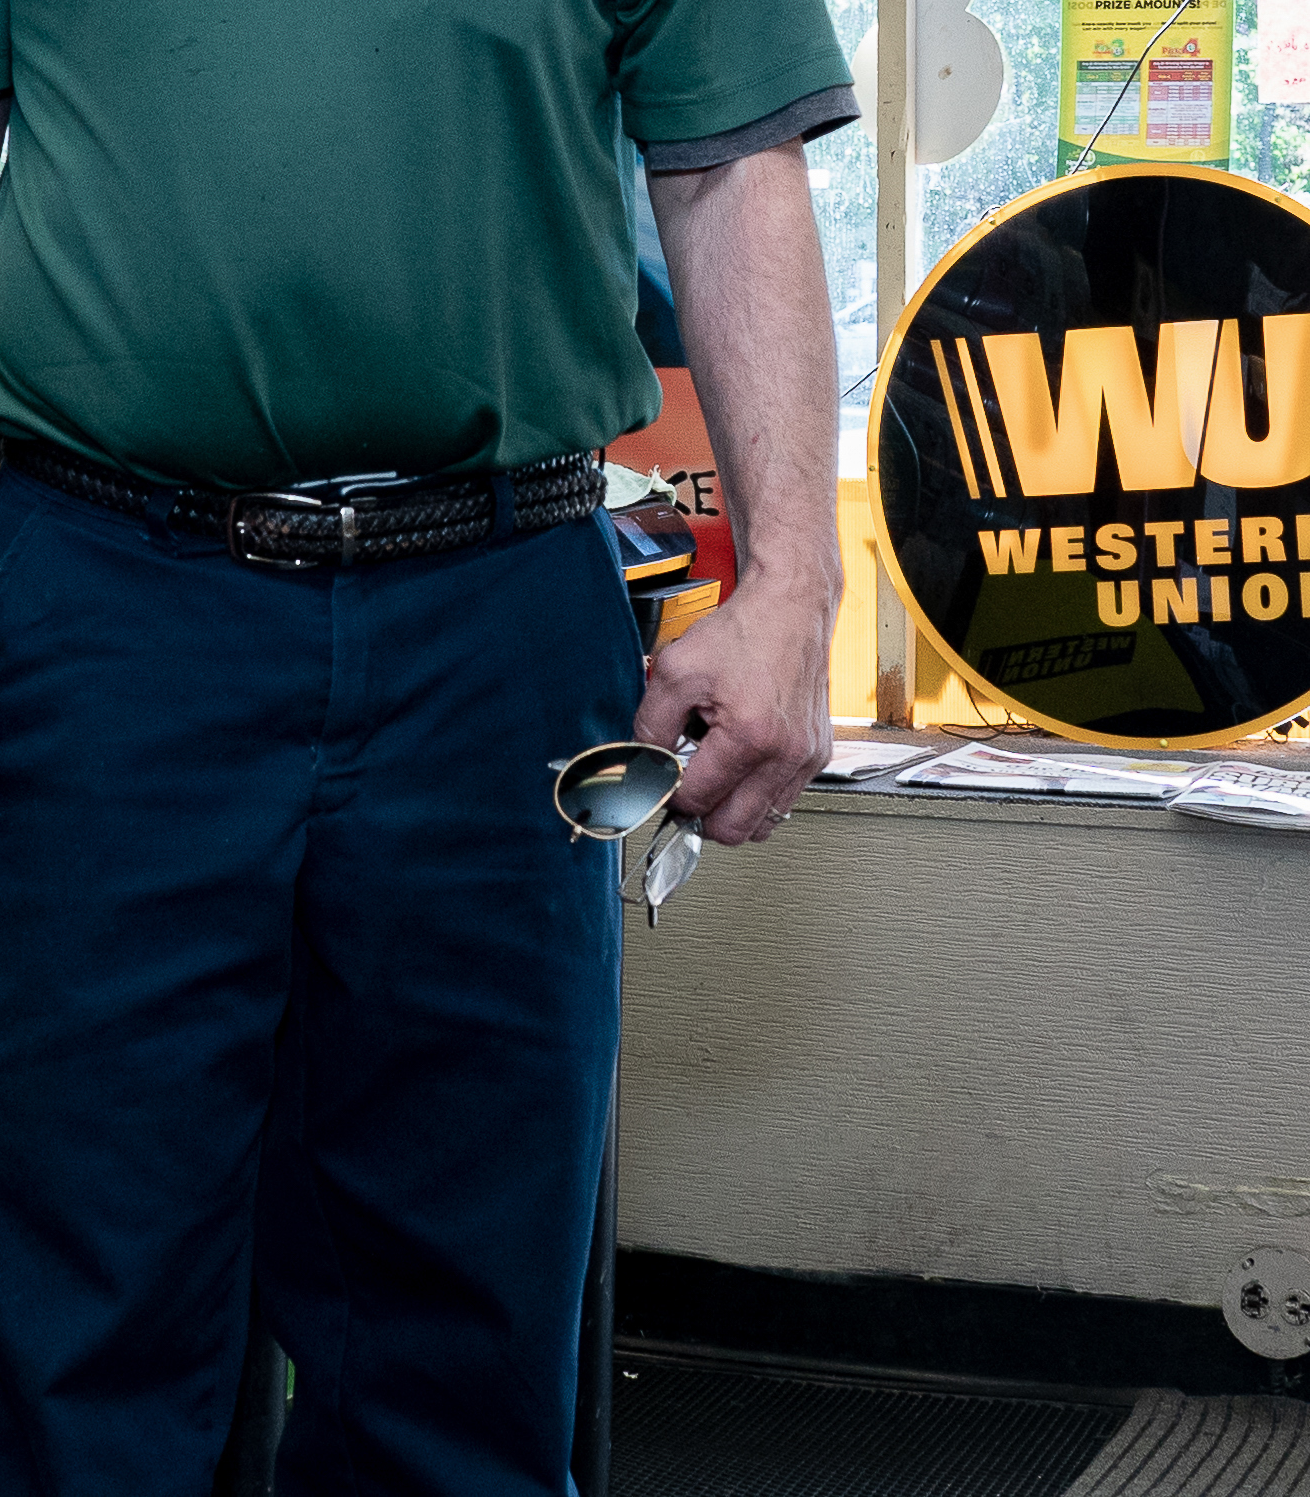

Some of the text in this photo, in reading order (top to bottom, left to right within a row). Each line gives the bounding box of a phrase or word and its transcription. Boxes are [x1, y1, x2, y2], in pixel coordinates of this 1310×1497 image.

[1095, 0, 1131, 10] PRIZE
[982, 313, 1310, 497] WU
[1097, 571, 1310, 627] UNIO
